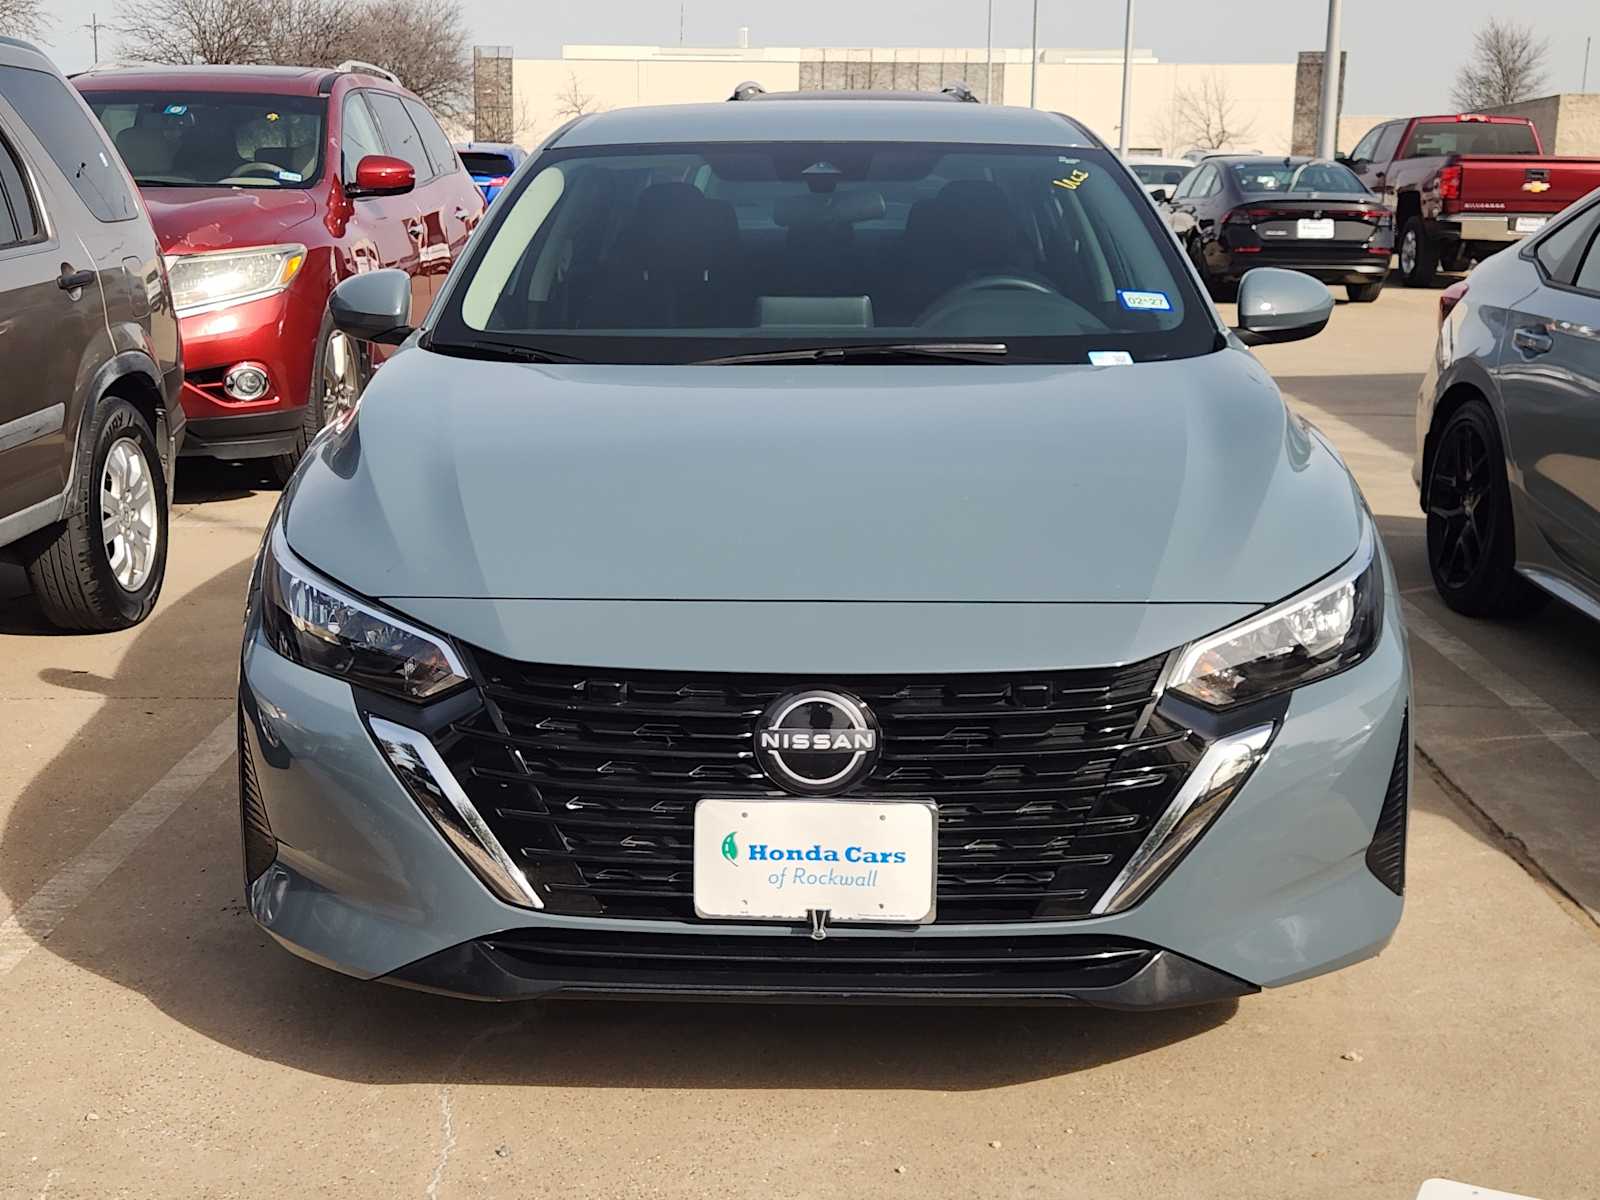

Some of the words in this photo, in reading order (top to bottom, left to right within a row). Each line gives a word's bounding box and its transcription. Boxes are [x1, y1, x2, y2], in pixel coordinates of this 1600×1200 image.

[760, 732, 874, 749] NISSAN
[748, 844, 840, 862] Honda
[844, 846, 906, 863] Cars
[768, 867, 788, 888] of
[793, 868, 878, 888] Rockwall
